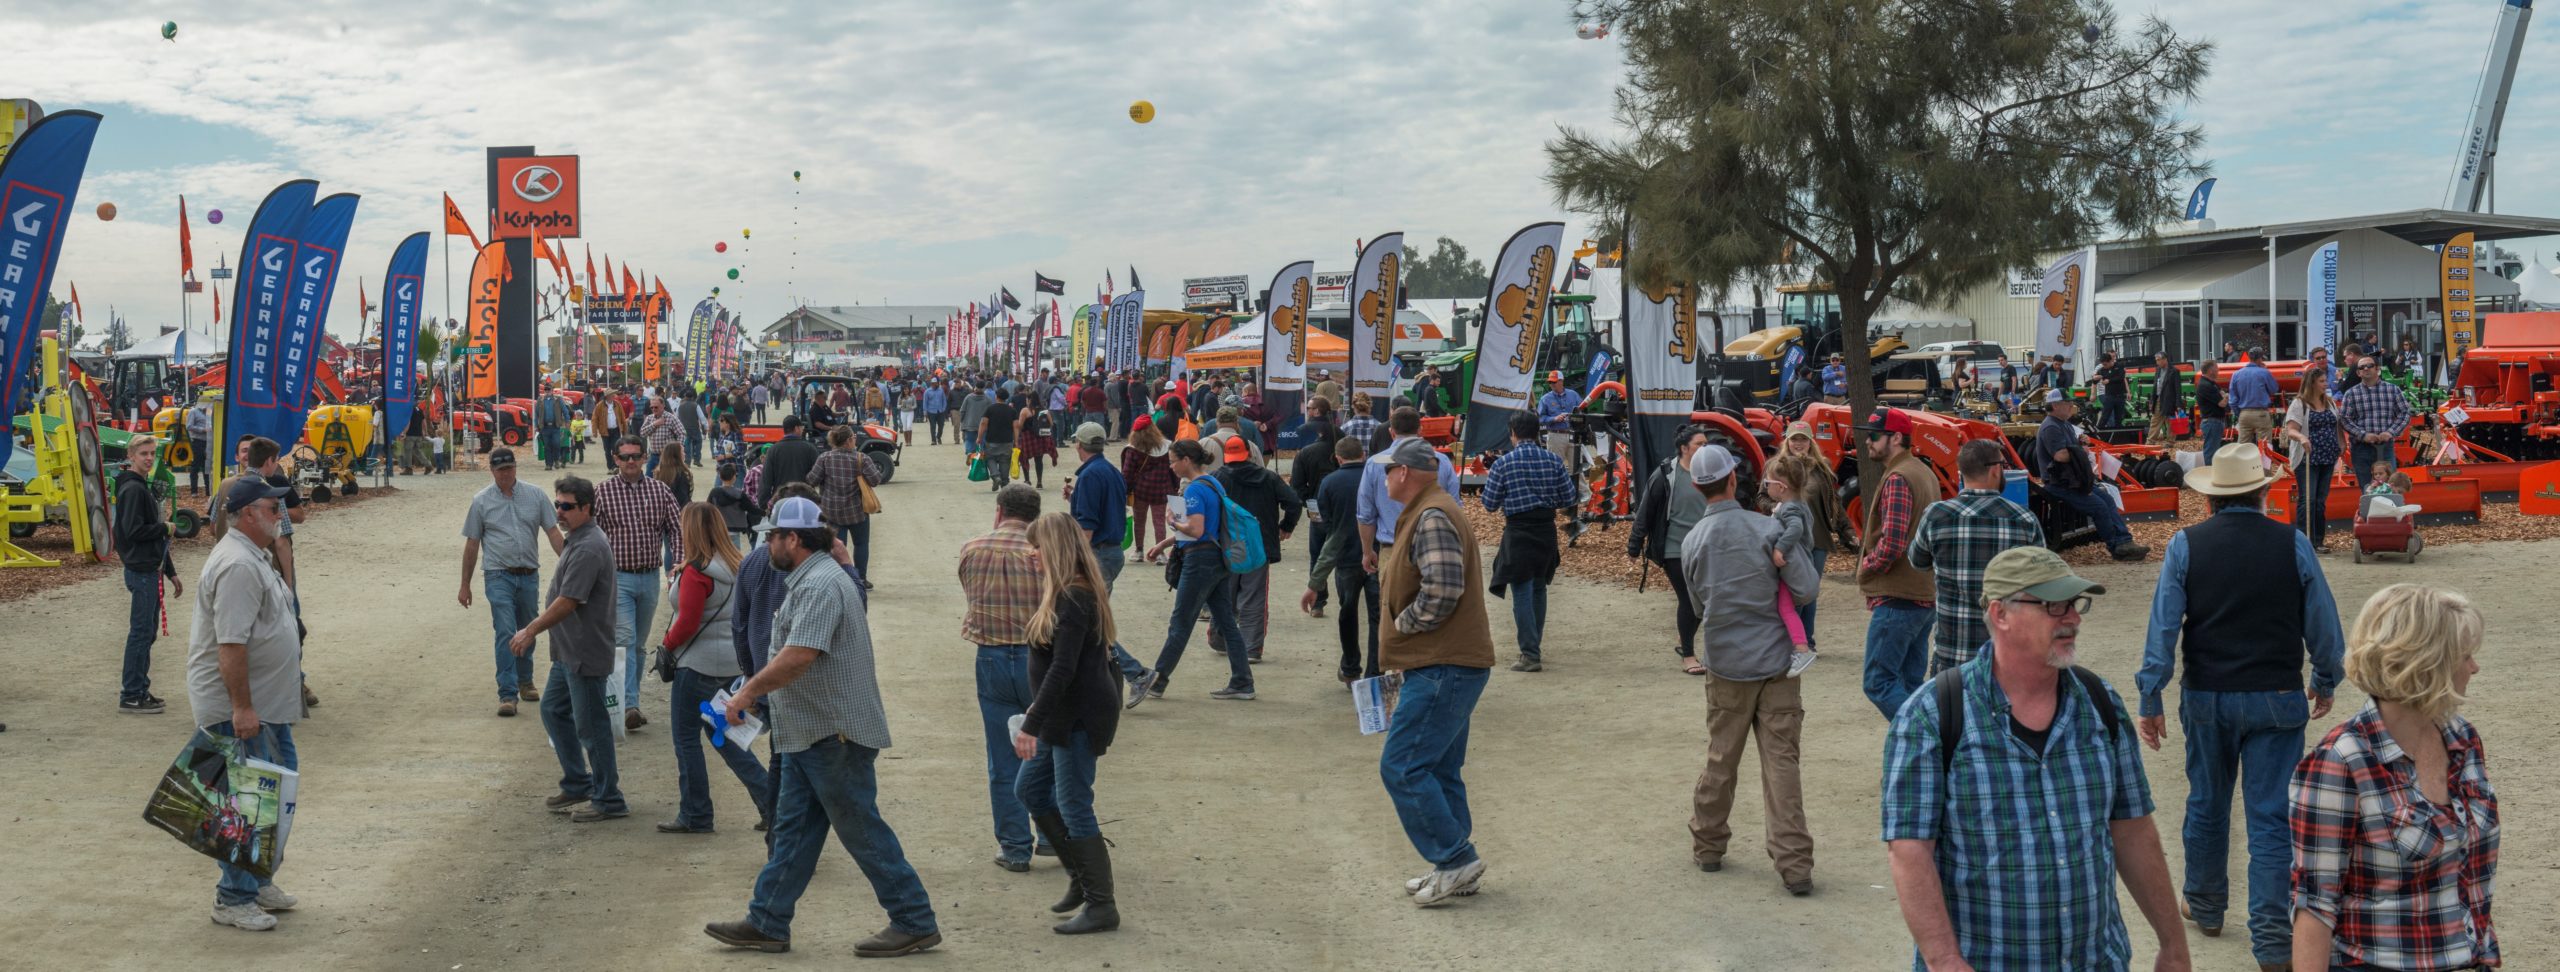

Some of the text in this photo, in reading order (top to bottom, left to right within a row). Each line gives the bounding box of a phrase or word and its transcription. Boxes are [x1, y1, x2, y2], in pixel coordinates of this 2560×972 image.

[2462, 126, 2483, 181] PACIFIC
[504, 210, 573, 228] Kubota
[2448, 246, 2469, 254] JCB
[0, 201, 46, 381] GEAR
[1372, 254, 1390, 361] Land Pride
[1510, 246, 1548, 368] Land Pride
[2020, 267, 2046, 281] EXHIB
[2448, 267, 2468, 275] JCB
[252, 246, 285, 391] GEARMORE
[285, 255, 325, 394] GEARMORE
[394, 282, 412, 390] GEARMORE
[473, 277, 499, 379] Kbota
[647, 314, 659, 371] Kubota
[1287, 277, 1304, 363] Land Pride
